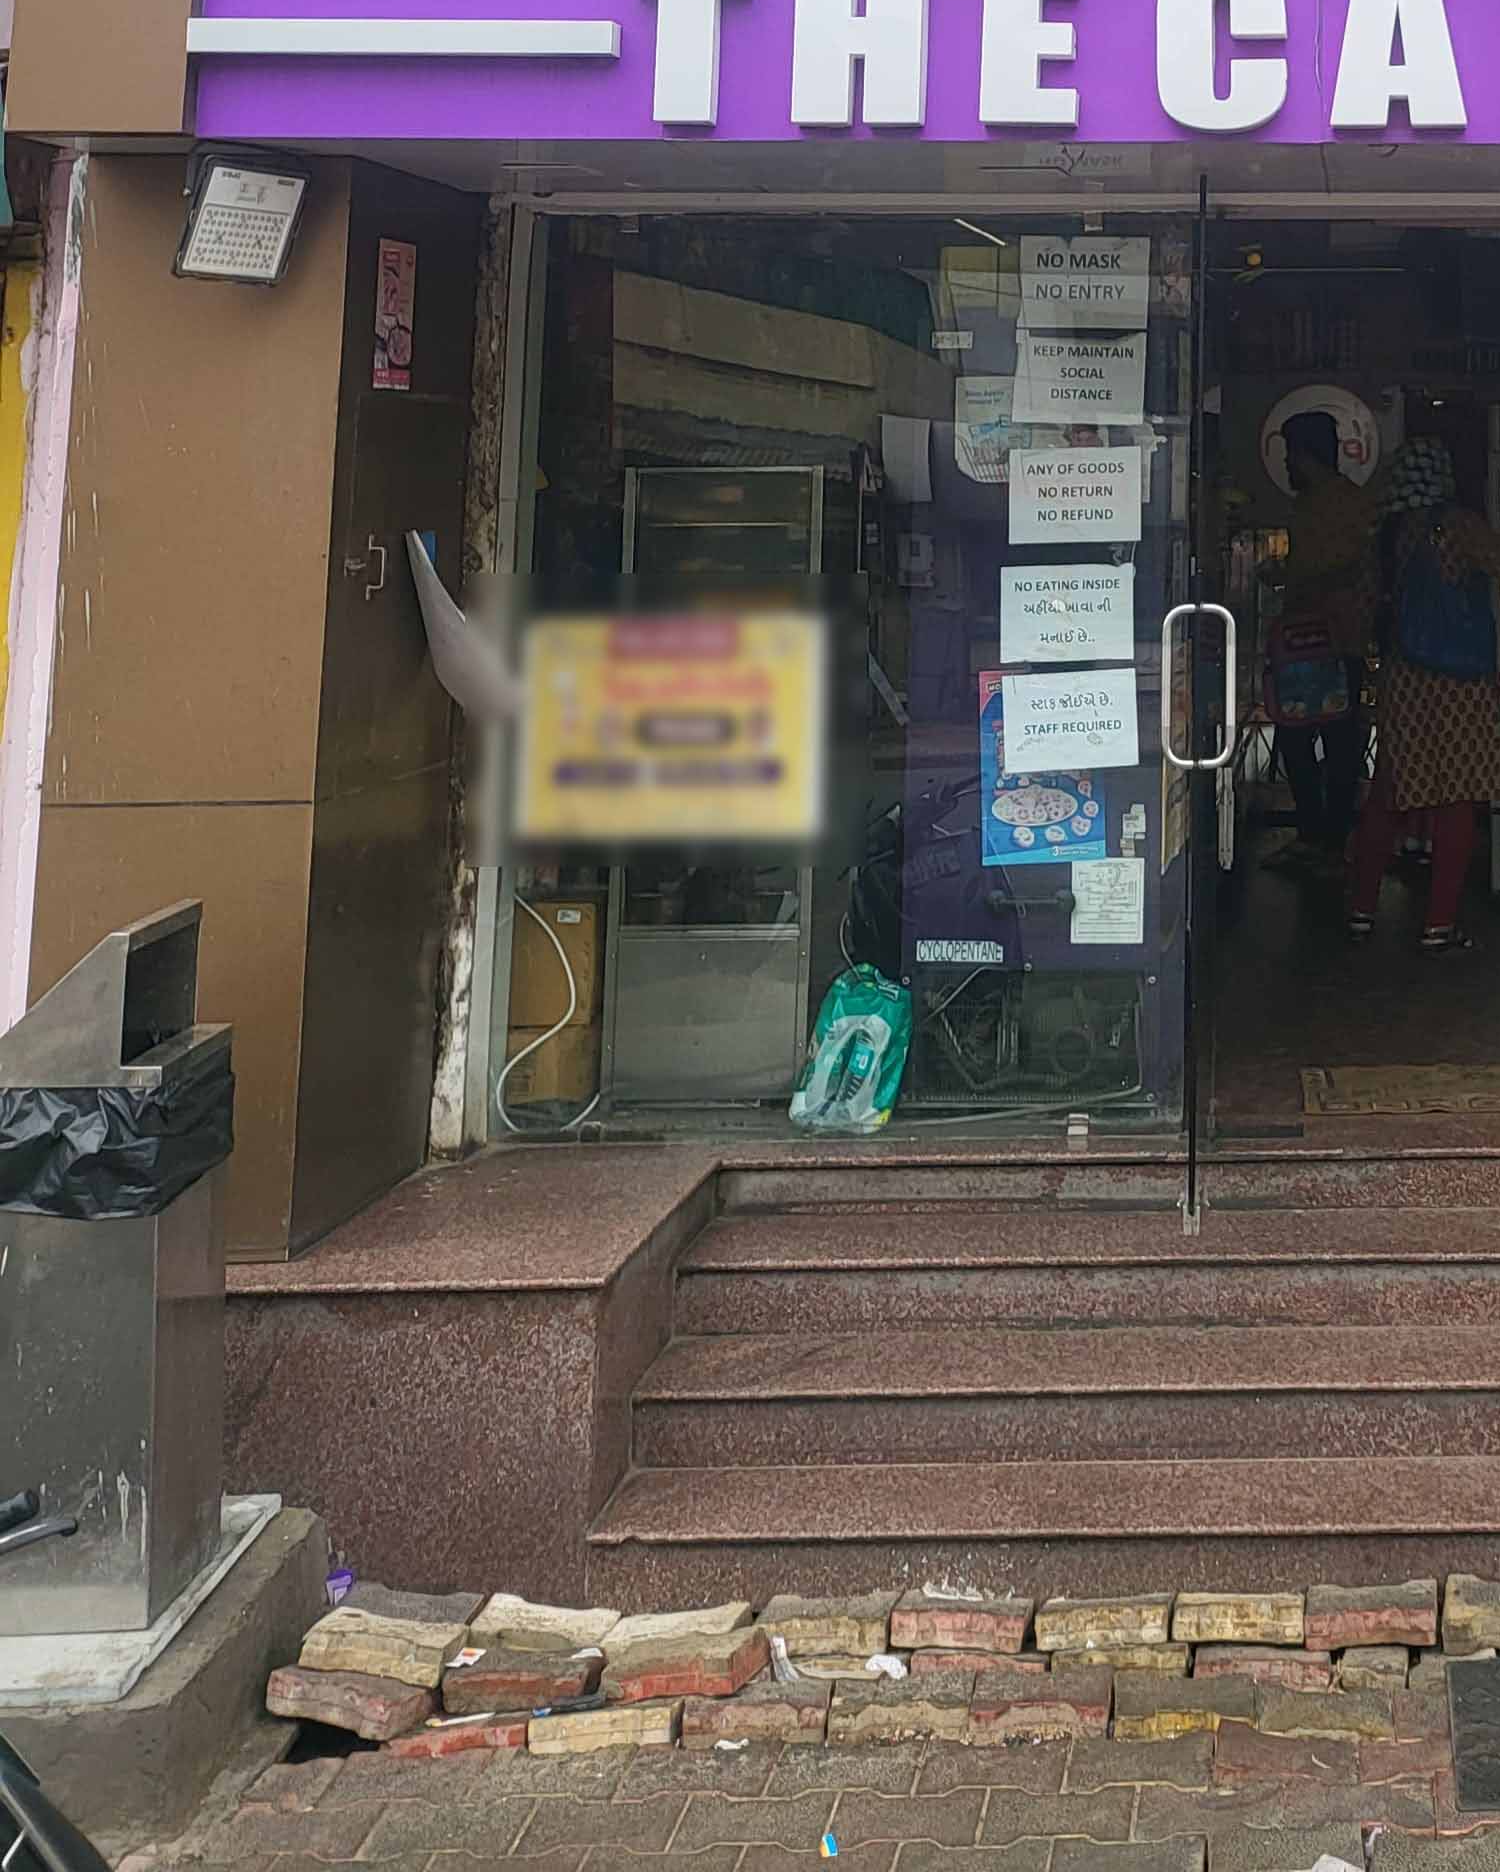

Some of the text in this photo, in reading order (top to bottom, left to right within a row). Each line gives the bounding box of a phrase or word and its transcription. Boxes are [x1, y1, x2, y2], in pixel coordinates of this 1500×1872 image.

[1036, 253, 1121, 269] NO MASK
[1035, 284, 1125, 299] NO ENTRY
[1033, 345, 1134, 359] KEEP MAINTAIN
[1060, 367, 1105, 379] SOCIAL
[1050, 388, 1113, 400] DISTANCE
[1027, 462, 1125, 475] ANY OF GOODS
[1038, 486, 1113, 498] NO RETURN
[1037, 509, 1113, 521] NO REFUND
[1014, 579, 1121, 592] NO EATING INSIDE
[1024, 720, 1122, 735] STAFF REQUIRED
[918, 942, 1002, 961] CYCLOPENTANE
